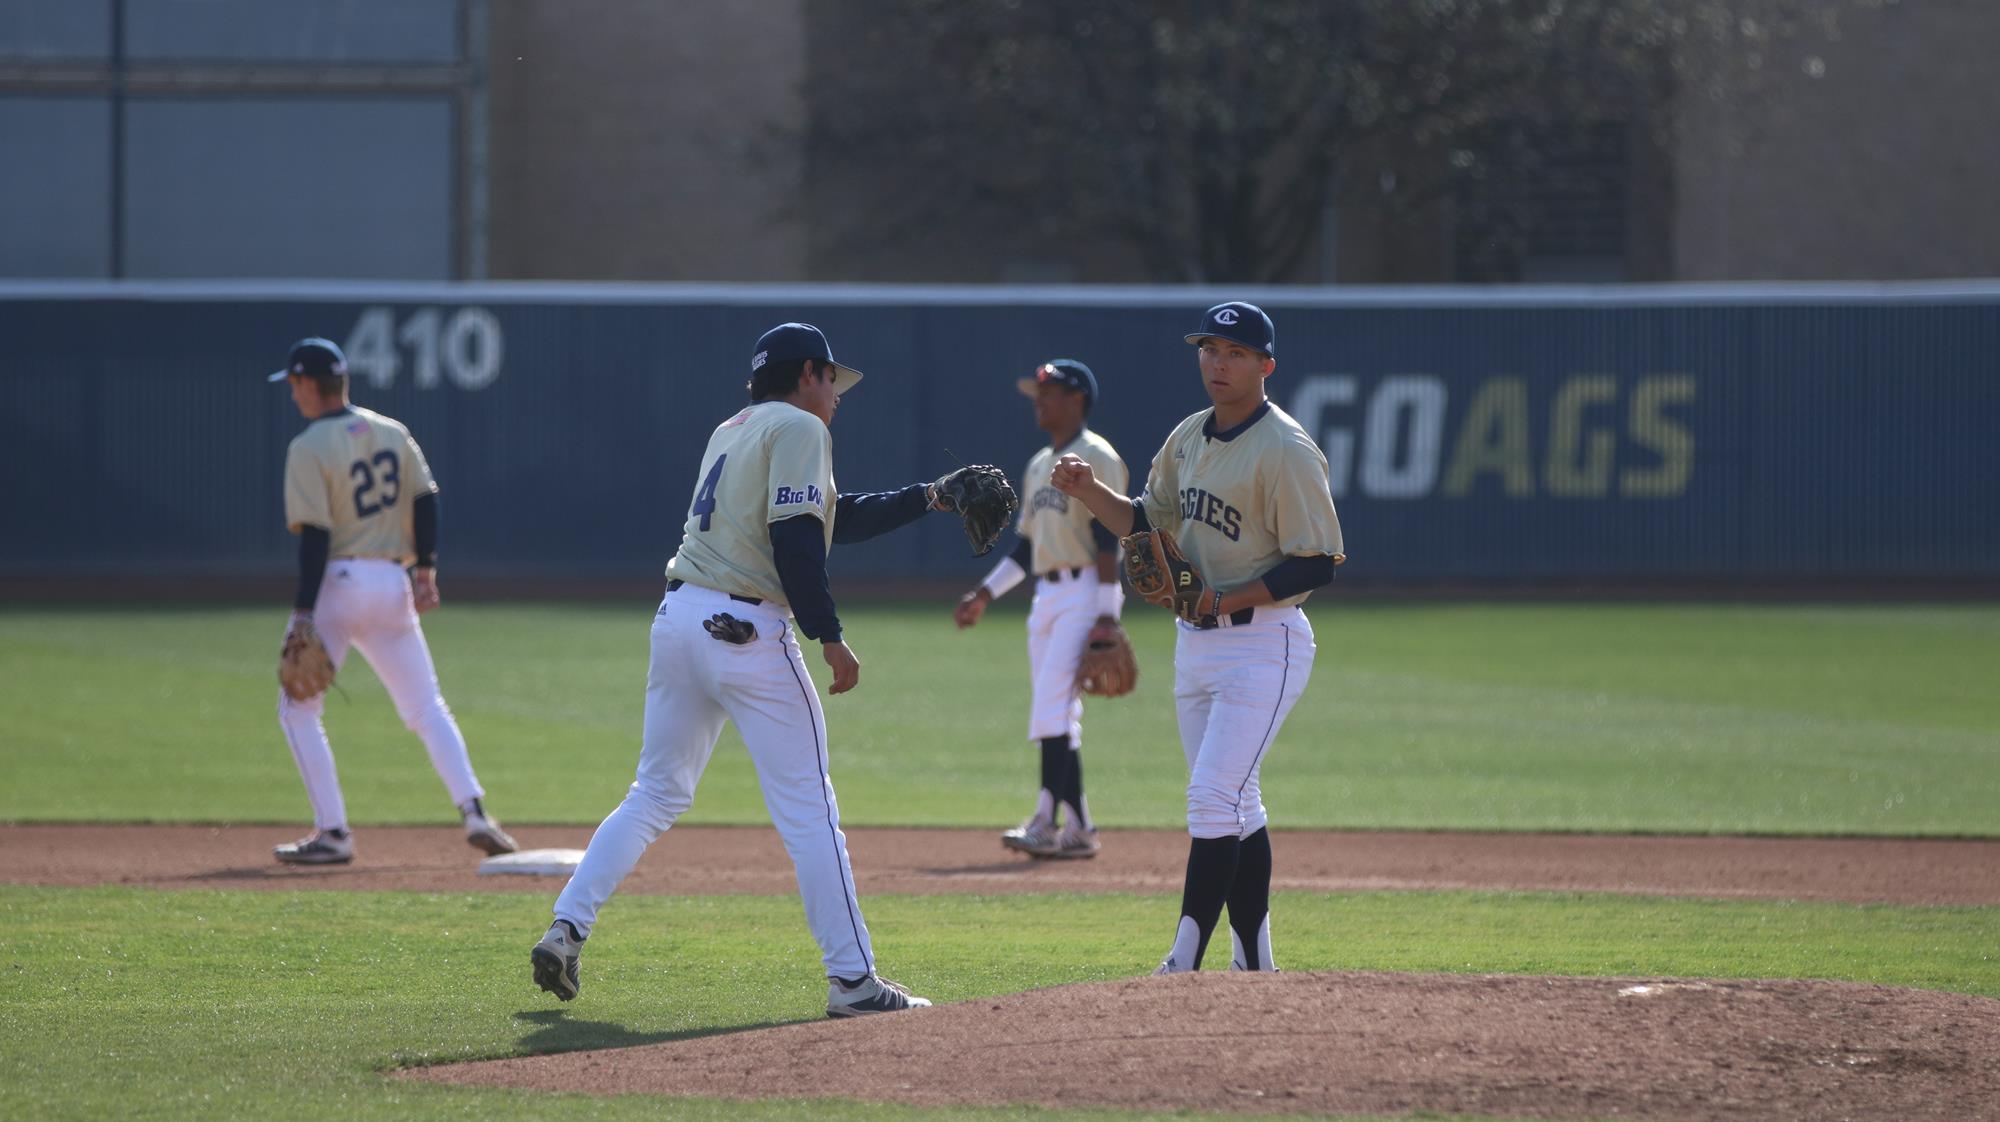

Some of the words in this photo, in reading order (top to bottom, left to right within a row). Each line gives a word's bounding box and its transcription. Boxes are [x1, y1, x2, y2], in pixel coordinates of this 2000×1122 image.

[345, 307, 502, 391] 410
[351, 450, 399, 518] 23
[692, 453, 727, 532] 4
